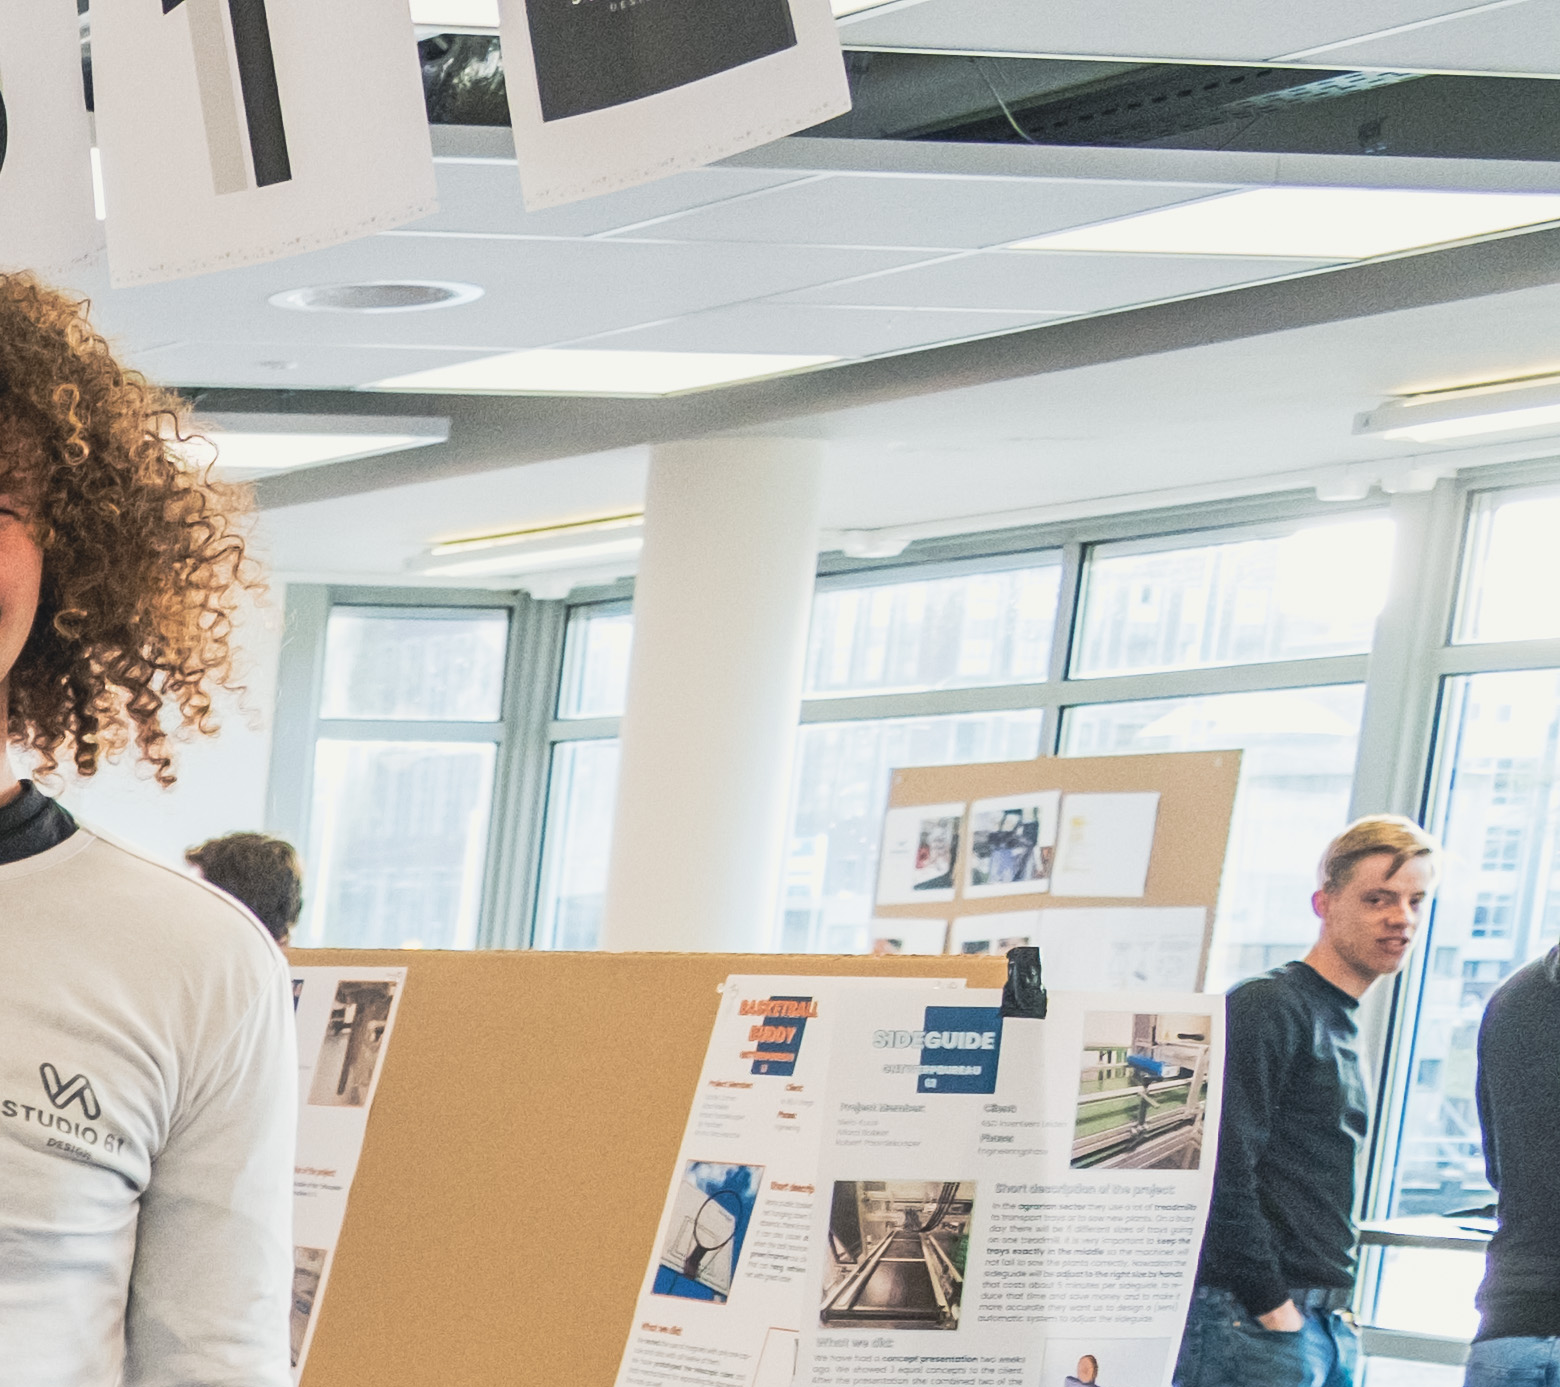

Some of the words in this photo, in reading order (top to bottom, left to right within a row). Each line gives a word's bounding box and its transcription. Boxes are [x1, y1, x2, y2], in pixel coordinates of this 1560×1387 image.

[739, 999, 818, 1018] BASKETBALL
[872, 1030, 996, 1049] SIDEGUIDE
[1, 1099, 98, 1145] STUDIO
[46, 1138, 92, 1160] DESIGN
[996, 1184, 1026, 1193] Short
[1030, 1184, 1095, 1196] description
